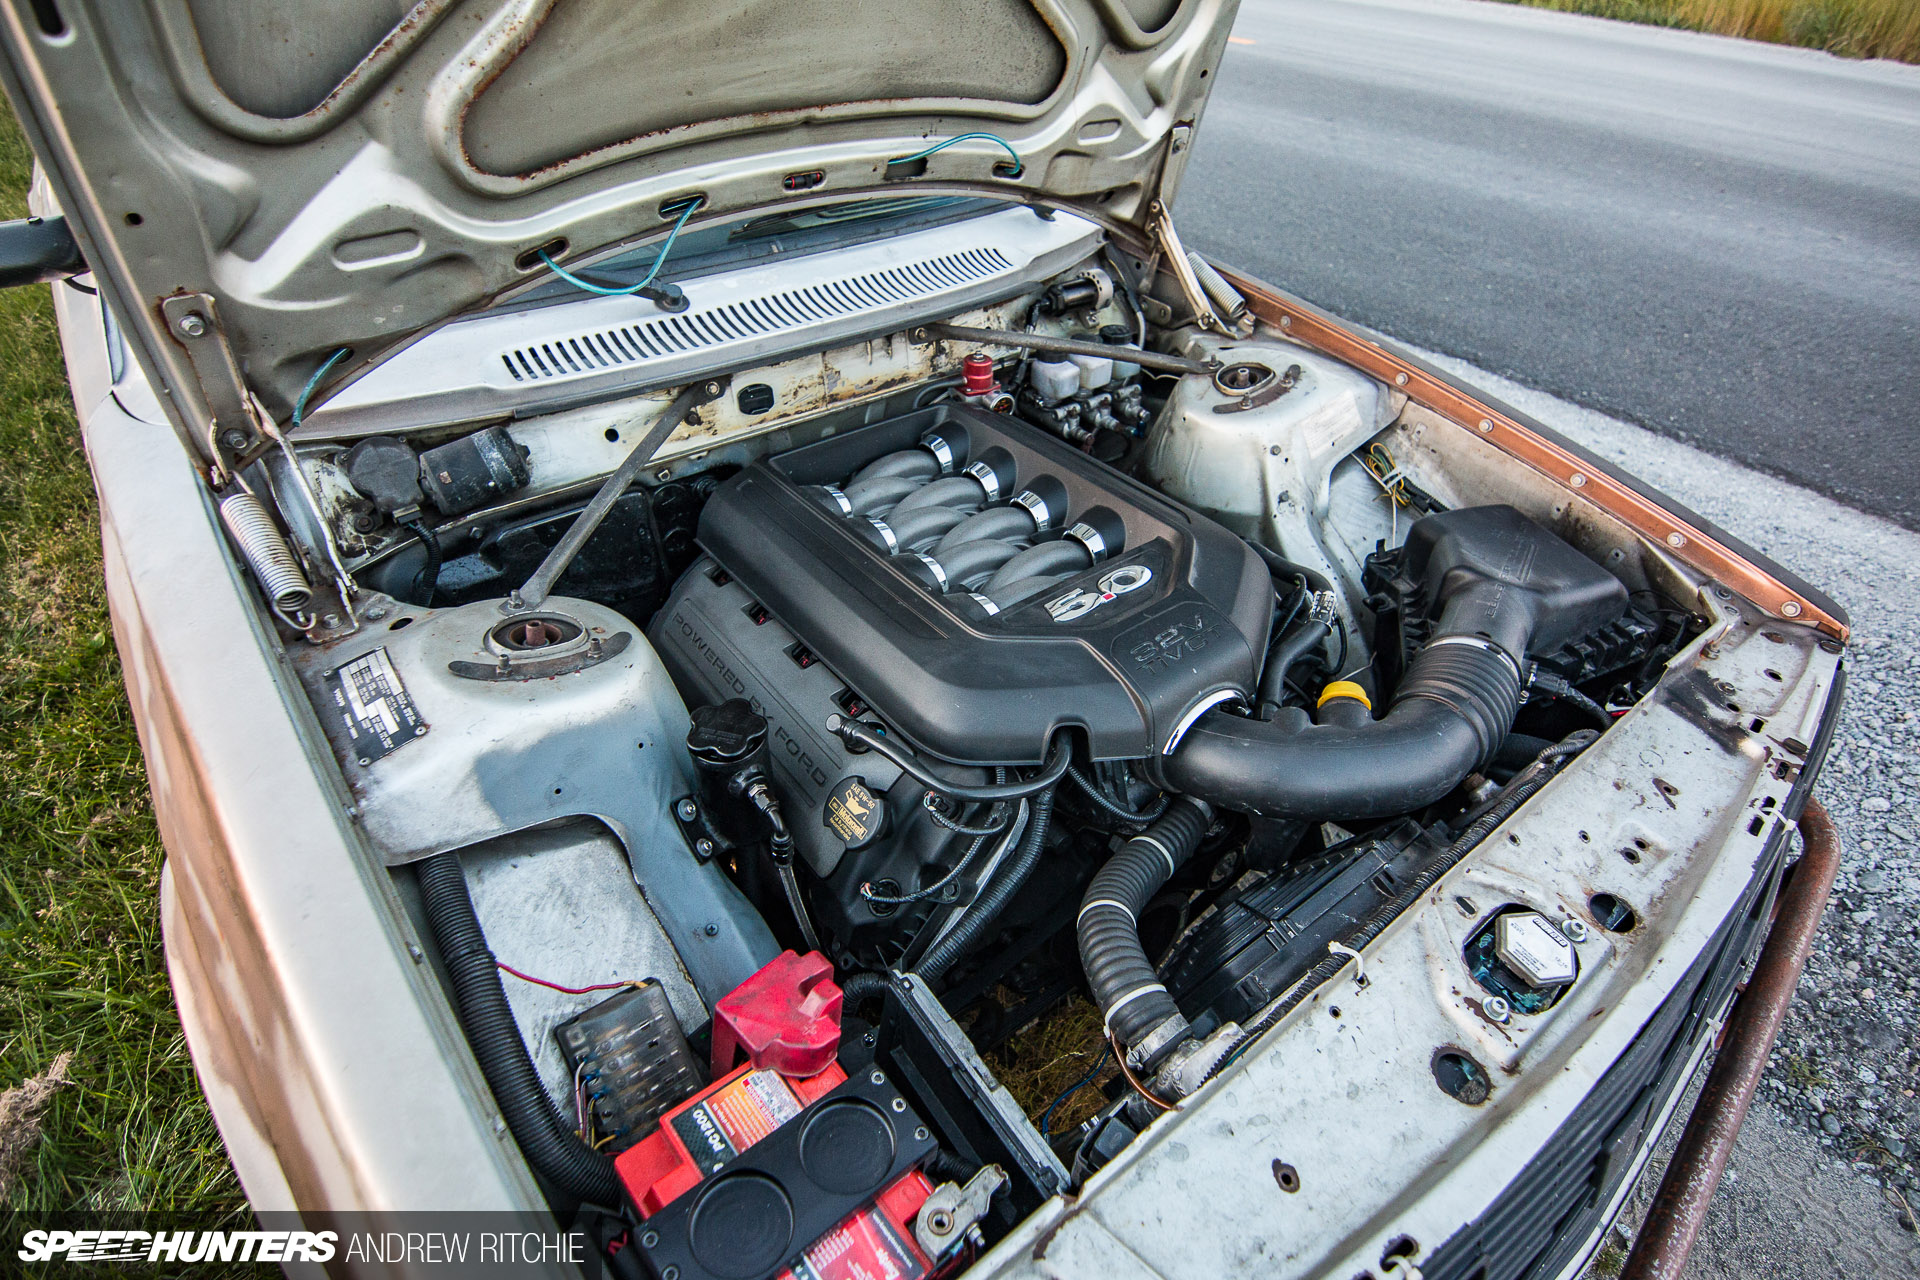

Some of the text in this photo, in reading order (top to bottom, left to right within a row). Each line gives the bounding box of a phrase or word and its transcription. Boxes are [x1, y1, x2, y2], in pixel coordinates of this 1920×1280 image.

[1044, 565, 1152, 622] 5.0
[1130, 614, 1203, 662] 32V
[672, 611, 746, 695] POWERED
[775, 727, 828, 788] FORD
[850, 783, 861, 794] SAE
[838, 807, 864, 837] Motorcraft
[692, 1109, 726, 1152] PC1200
